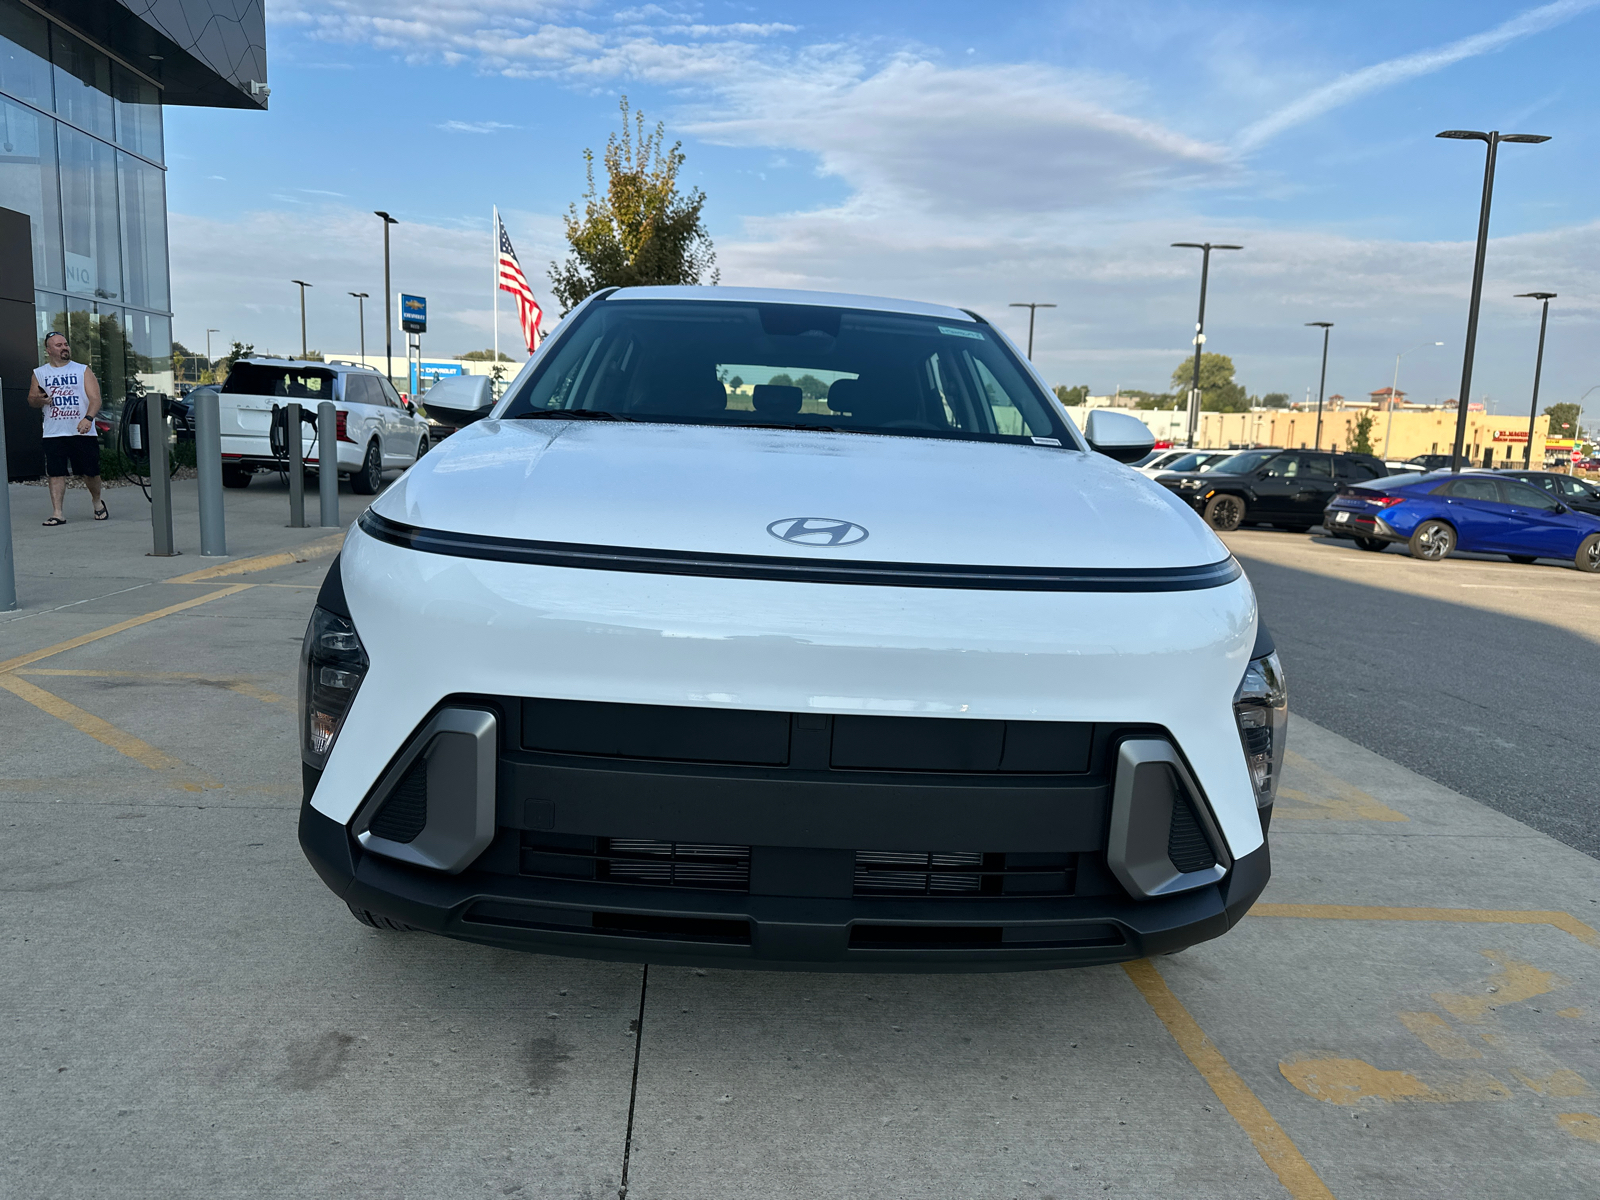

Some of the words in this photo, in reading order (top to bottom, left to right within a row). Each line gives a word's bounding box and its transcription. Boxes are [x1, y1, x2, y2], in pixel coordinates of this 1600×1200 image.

[45, 376, 77, 387] LAND
[50, 386, 74, 397] Free
[51, 406, 80, 418] Brave
